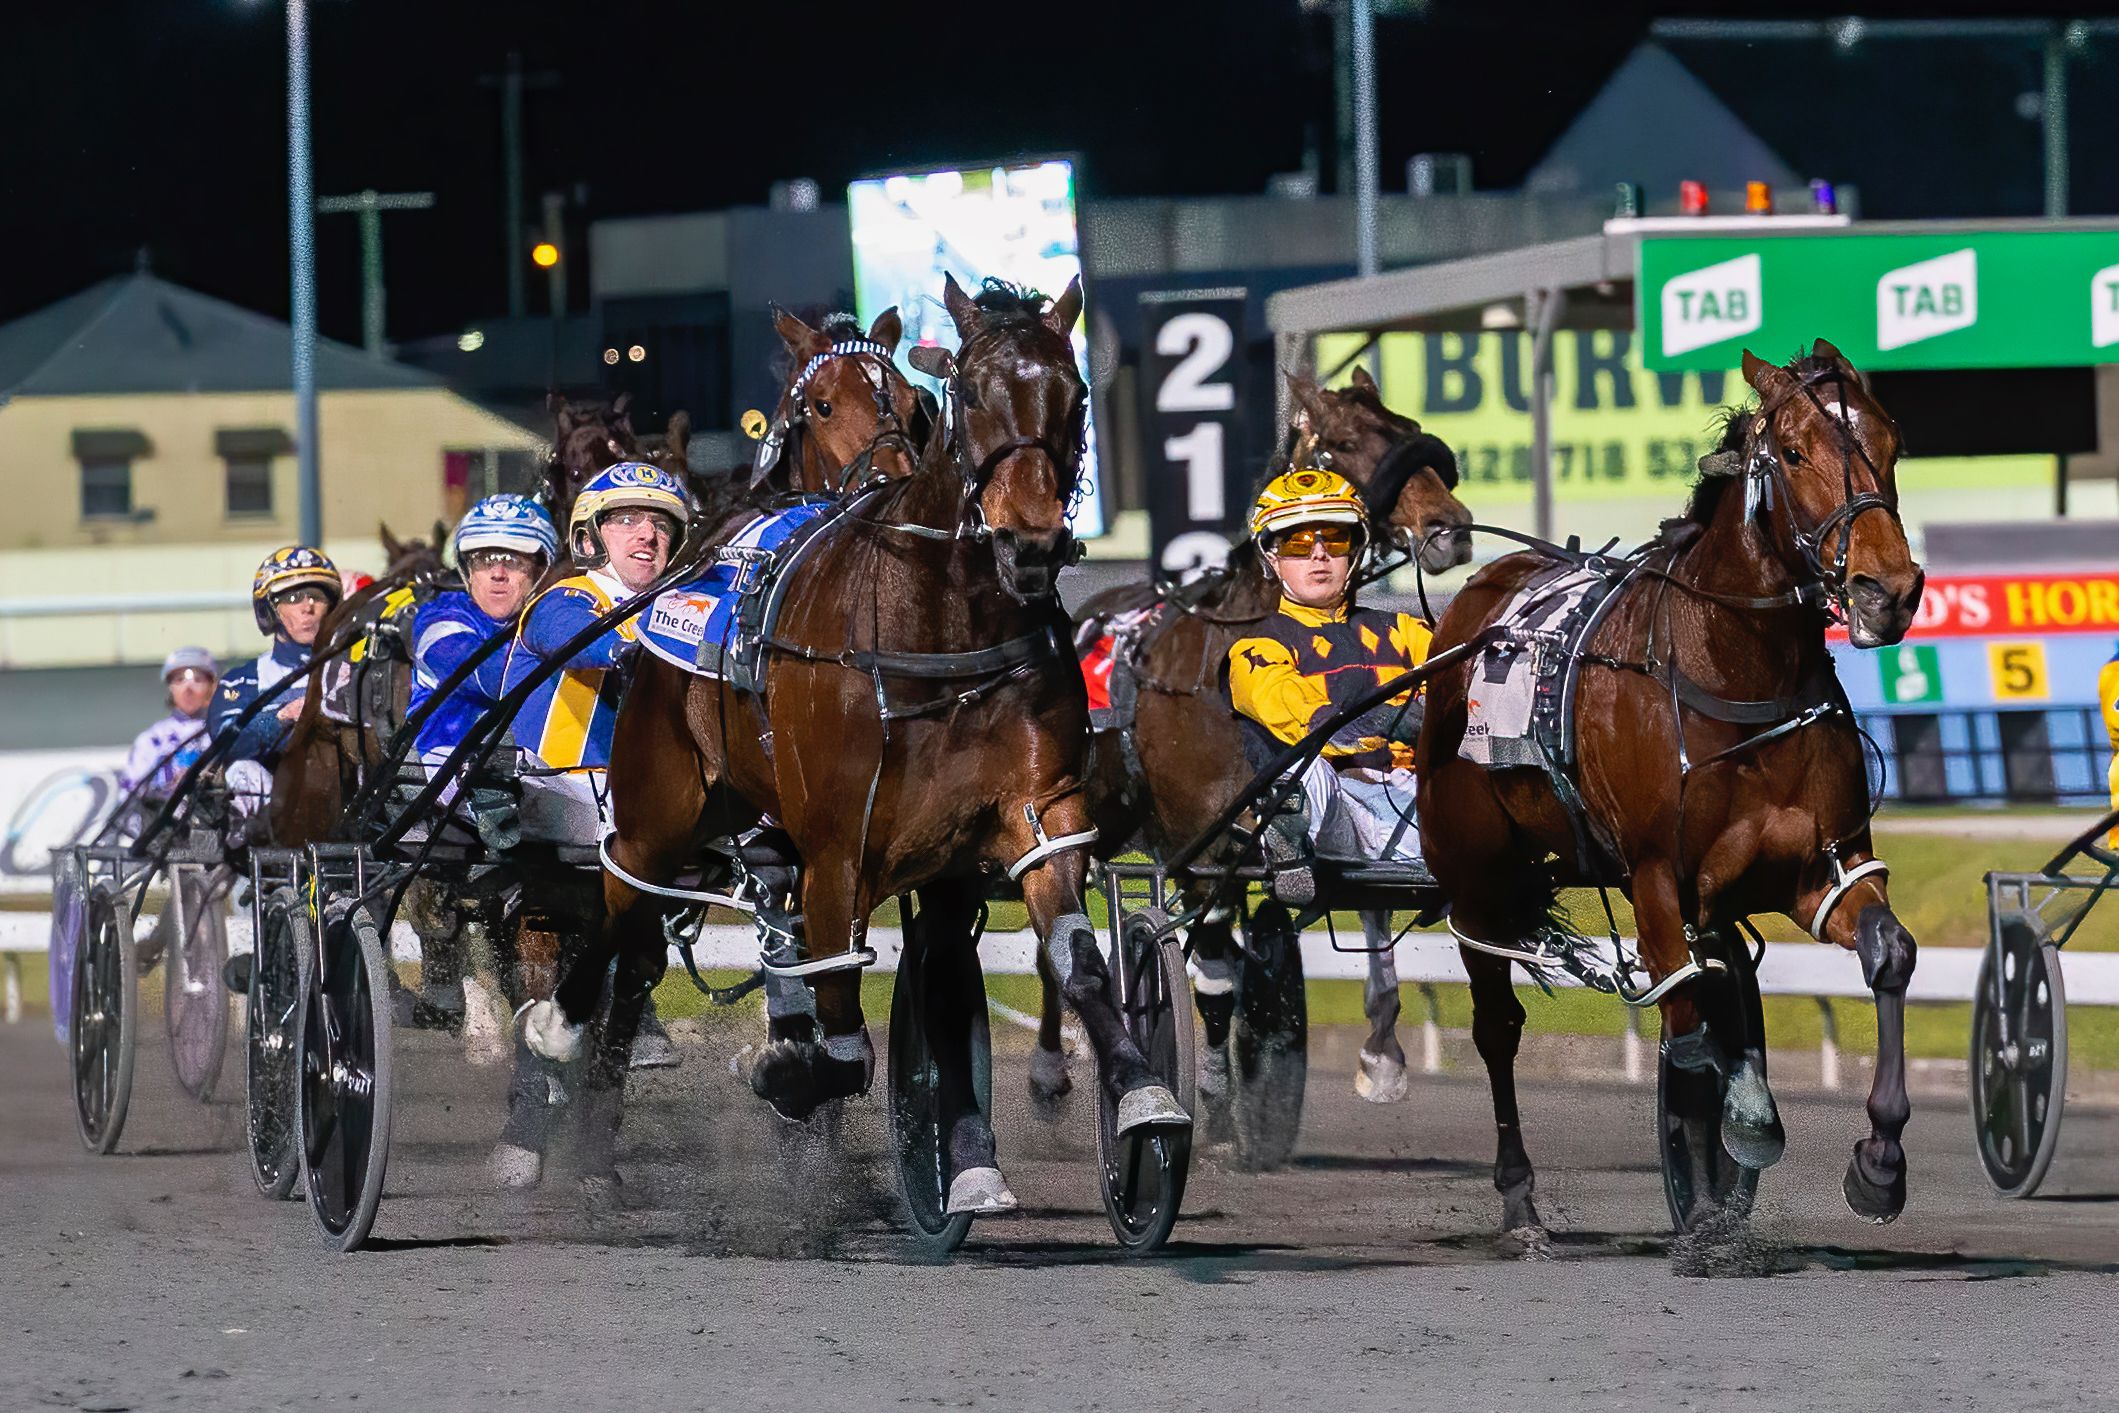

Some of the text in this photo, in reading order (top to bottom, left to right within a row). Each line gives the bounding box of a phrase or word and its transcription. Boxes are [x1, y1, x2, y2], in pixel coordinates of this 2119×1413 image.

[1675, 287, 1749, 321] TAB
[1891, 282, 1965, 316] TAB
[1155, 312, 1234, 412] 2
[1164, 421, 1226, 520] 1
[655, 609, 680, 628] The
[2005, 579, 2119, 627] HOR
[2002, 649, 2035, 693] 5
